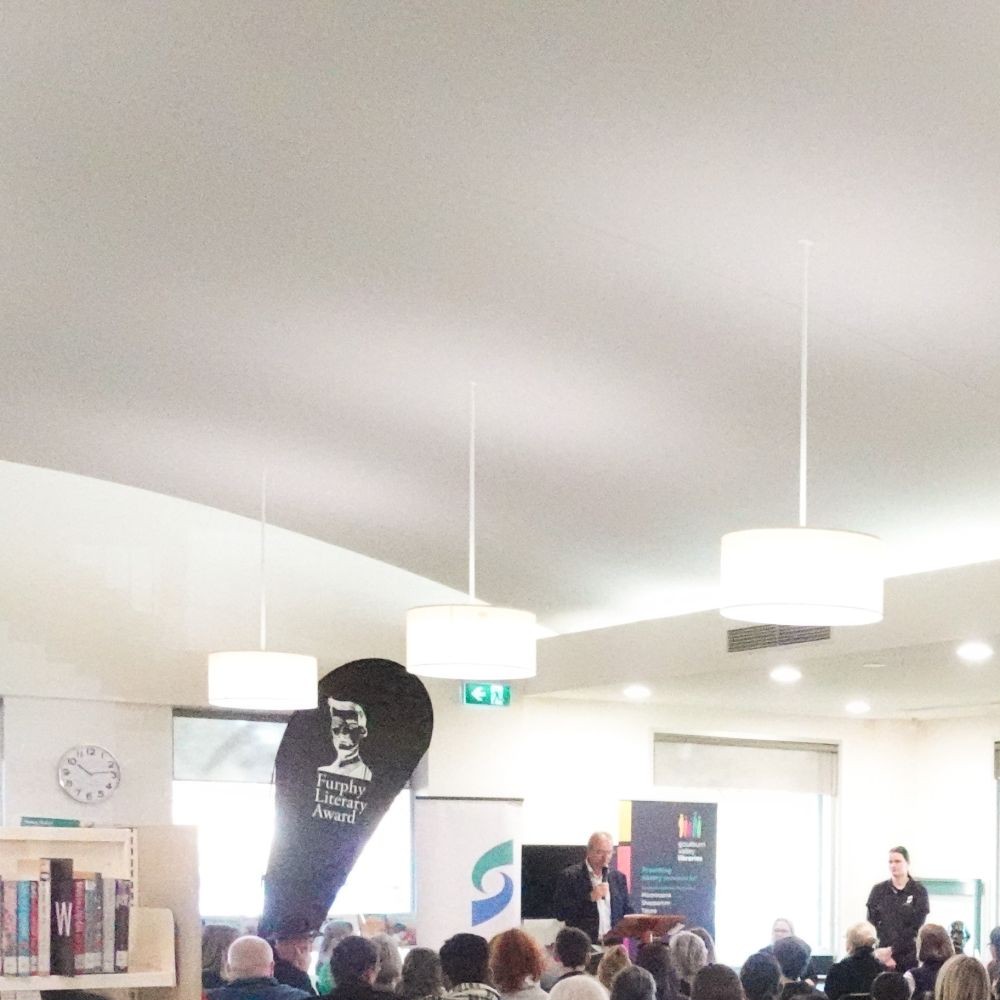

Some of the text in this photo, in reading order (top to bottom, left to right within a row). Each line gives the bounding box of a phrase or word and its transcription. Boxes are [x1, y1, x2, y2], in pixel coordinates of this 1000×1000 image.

[317, 773, 366, 799] Furphy
[312, 803, 355, 824] Award
[315, 788, 368, 815] Literary
[55, 901, 73, 937] W
